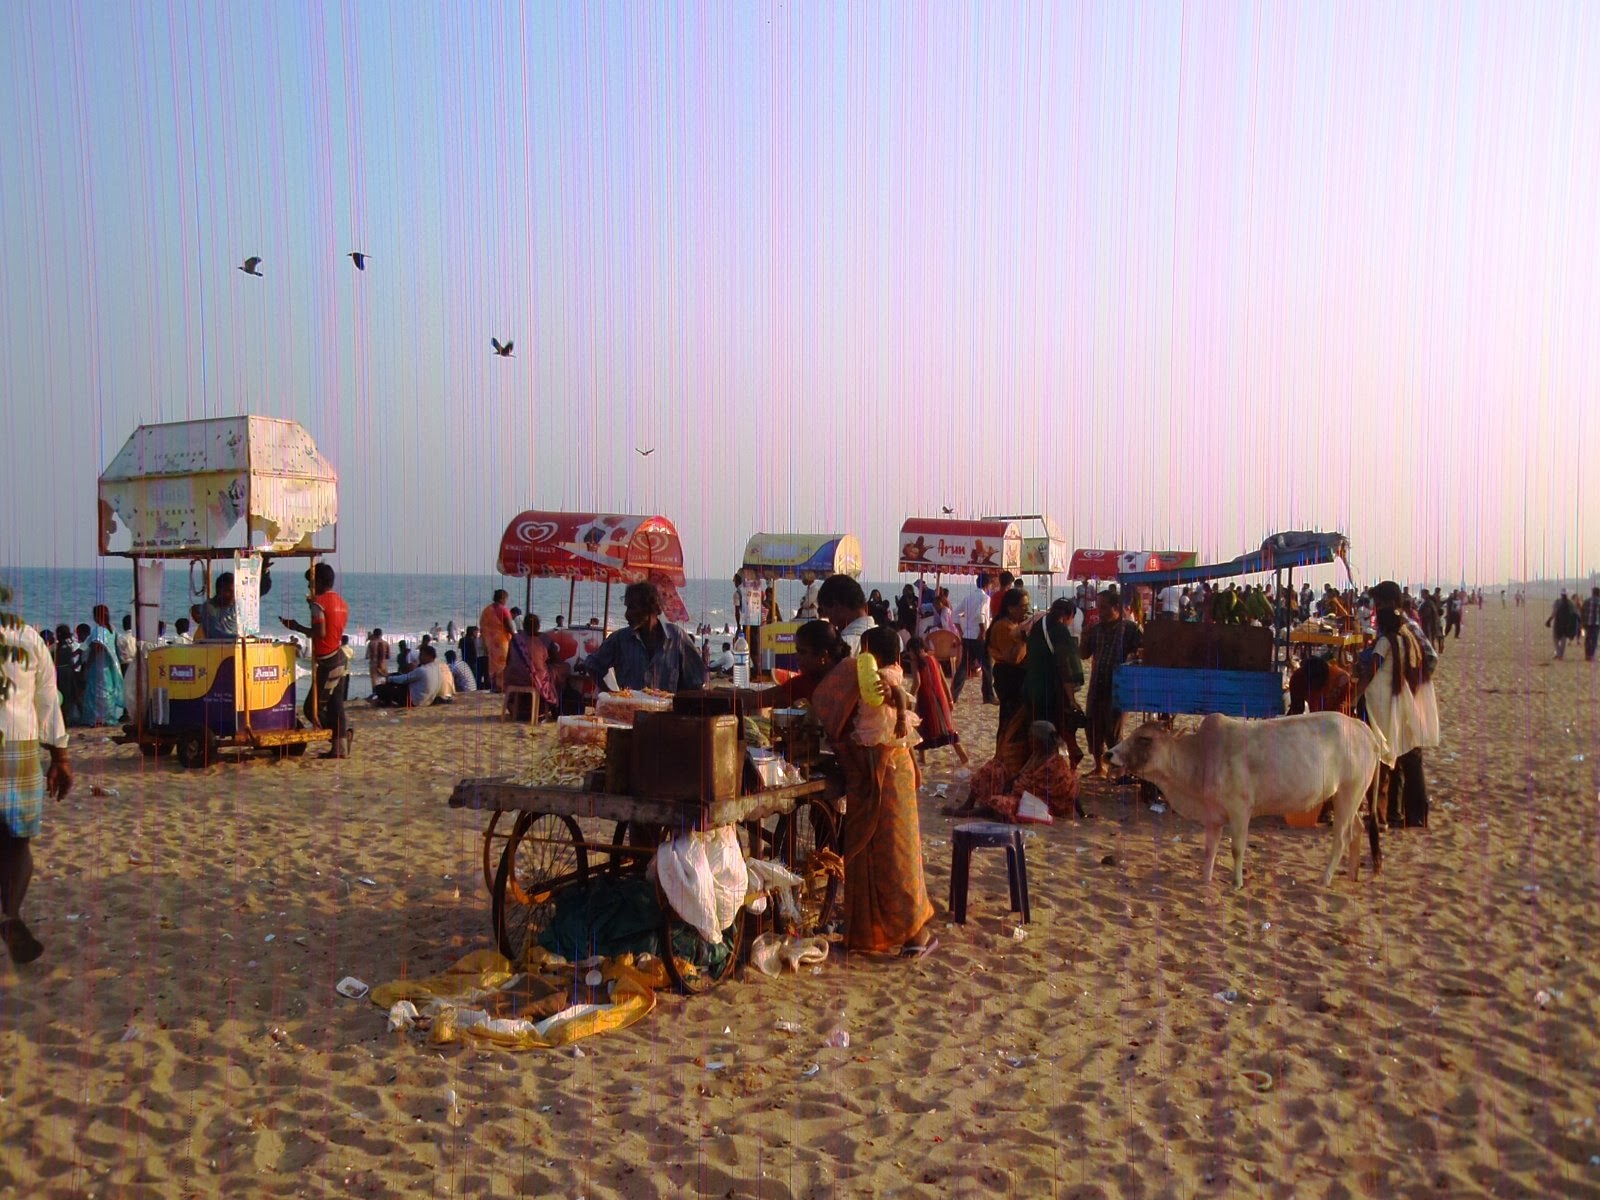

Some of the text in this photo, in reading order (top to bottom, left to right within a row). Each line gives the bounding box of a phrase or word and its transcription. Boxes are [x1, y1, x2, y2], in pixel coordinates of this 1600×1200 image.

[938, 538, 965, 557] Arun
[171, 666, 194, 678] Amul
[255, 667, 278, 678] Amul
